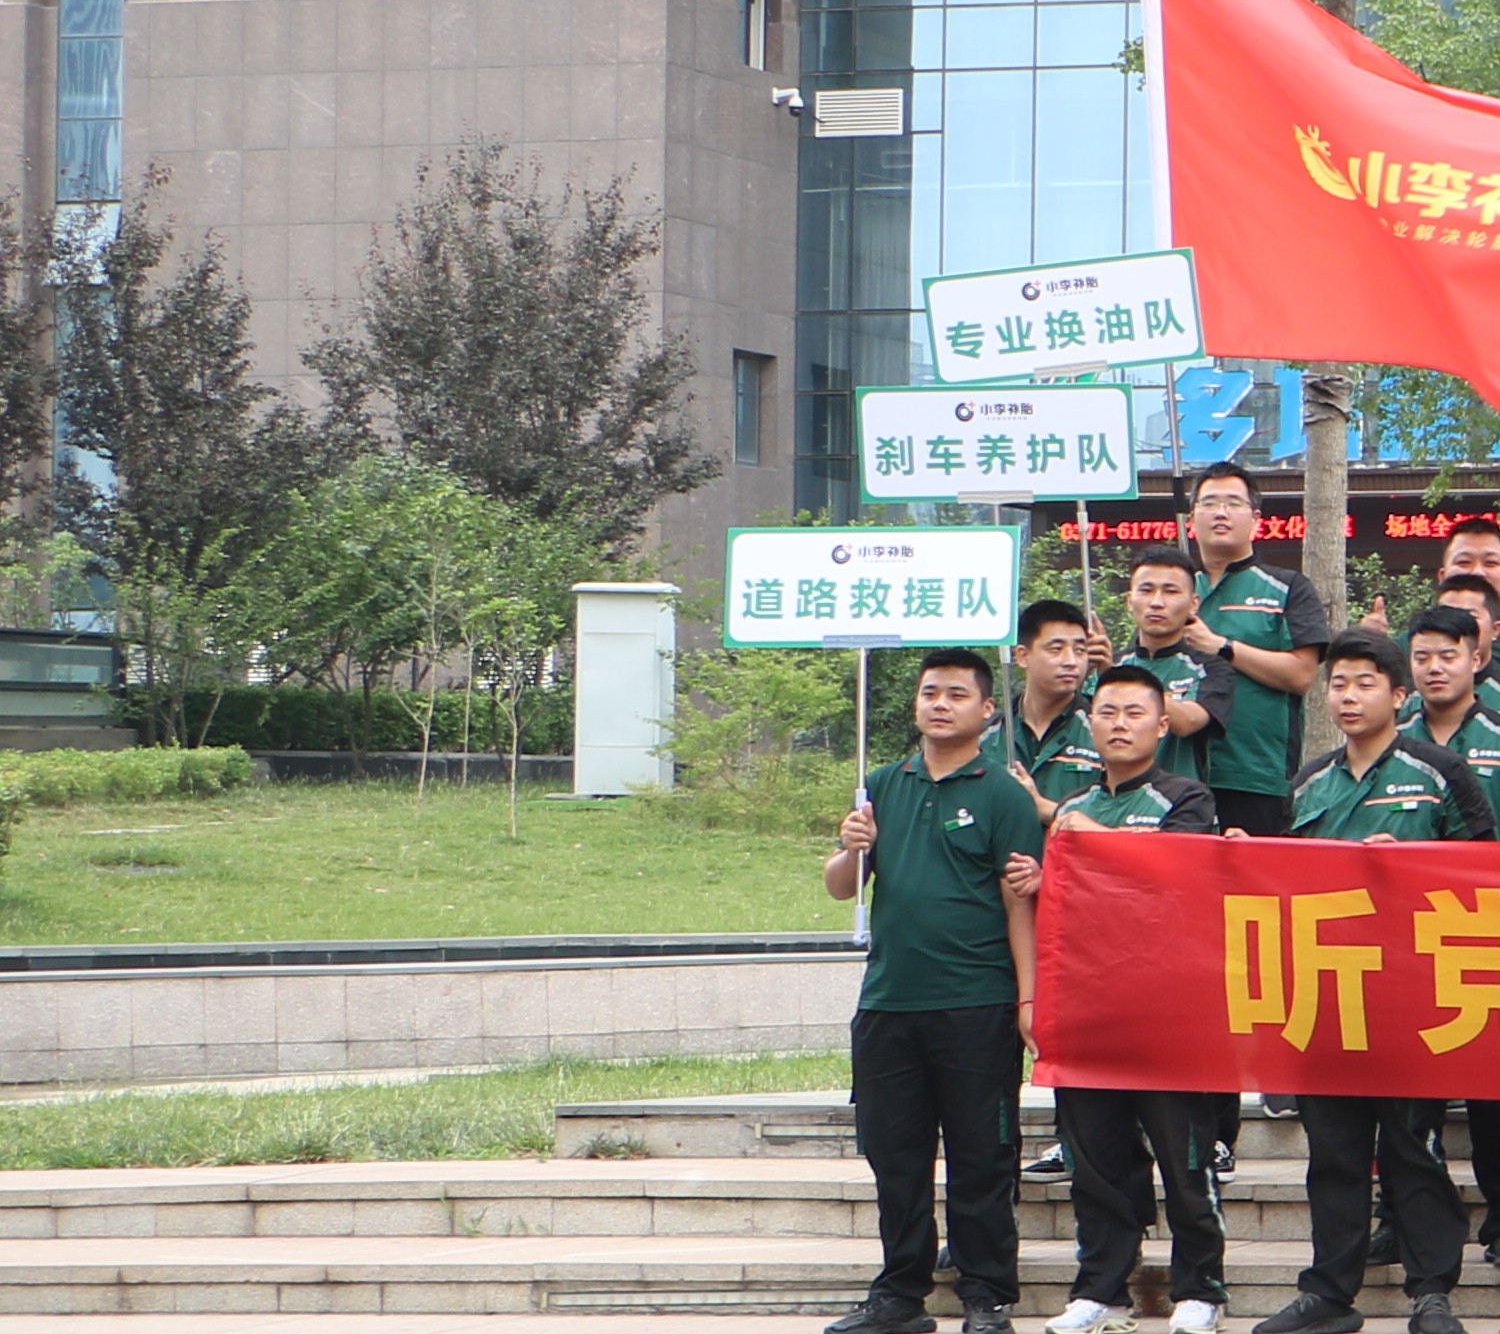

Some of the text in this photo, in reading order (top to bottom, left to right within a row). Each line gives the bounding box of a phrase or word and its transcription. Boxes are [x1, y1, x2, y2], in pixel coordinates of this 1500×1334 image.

[945, 297, 1186, 359] 专业换油队
[875, 432, 1119, 476] 刹车养护队
[742, 577, 998, 620] 道路救援队
